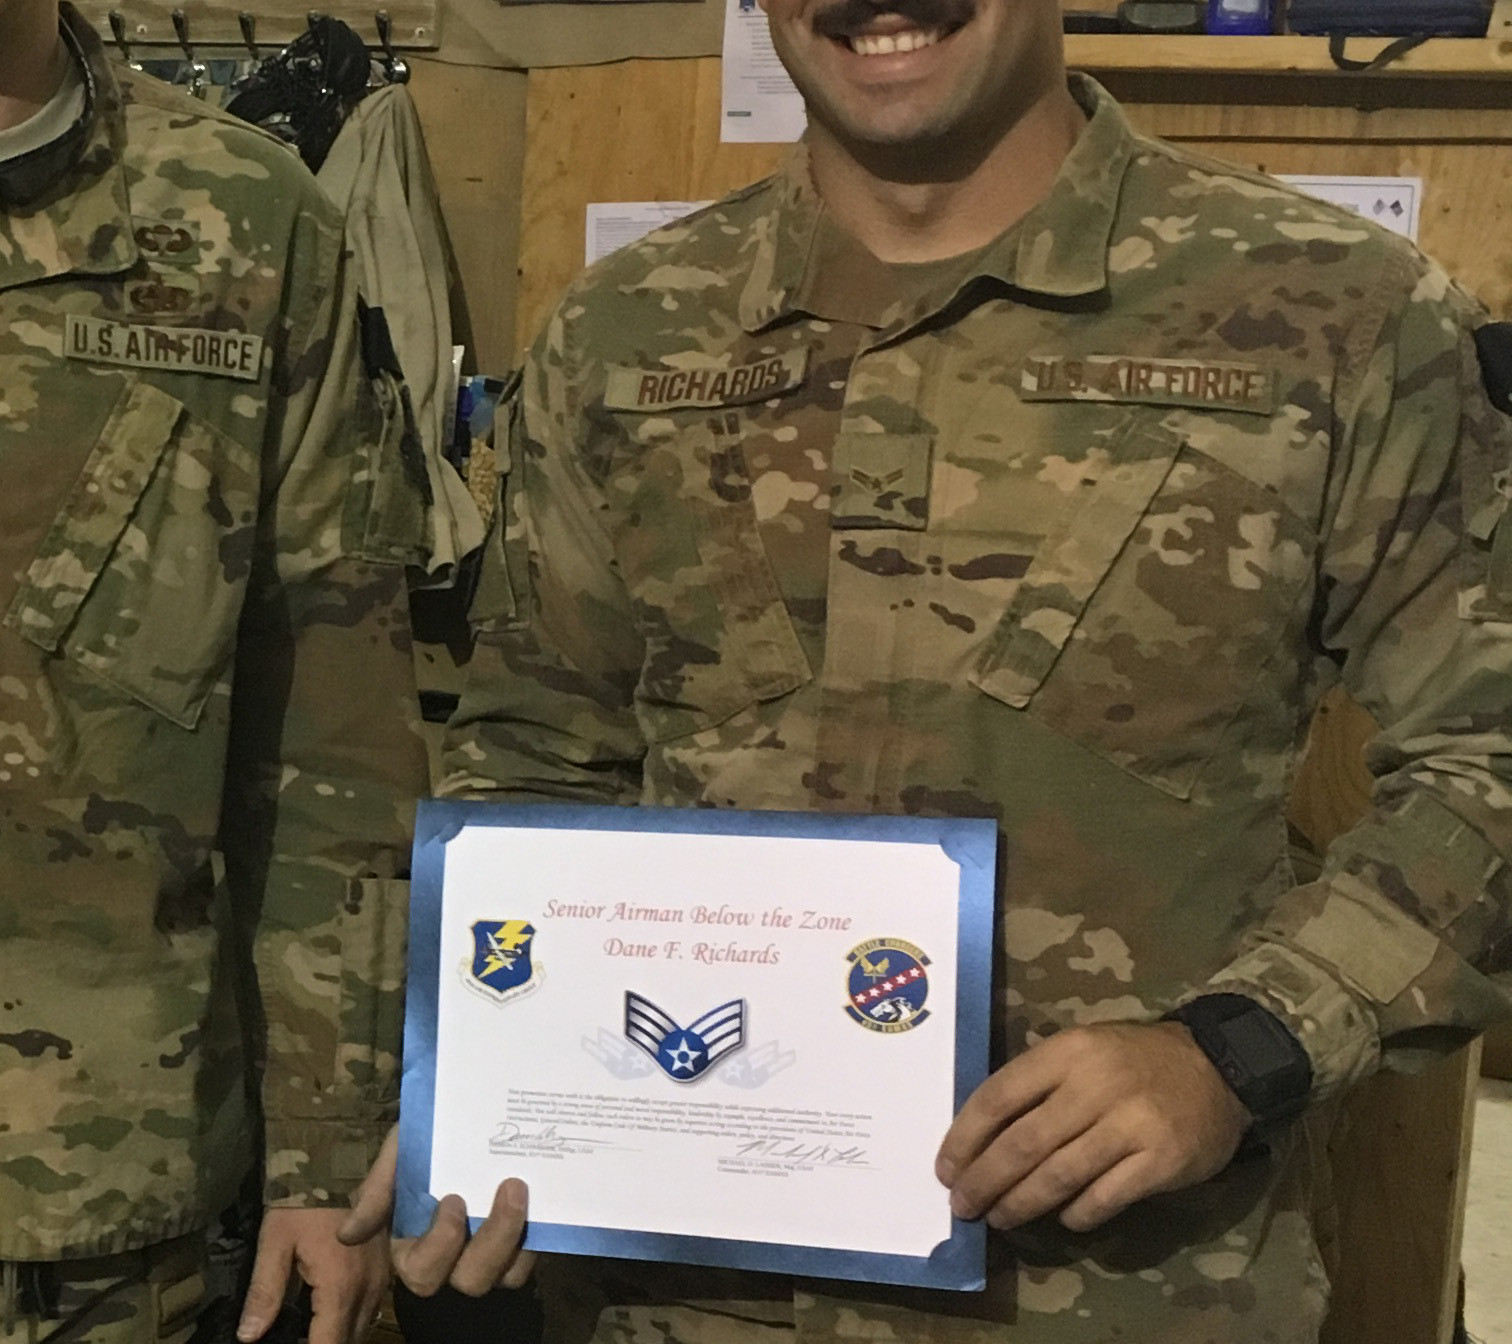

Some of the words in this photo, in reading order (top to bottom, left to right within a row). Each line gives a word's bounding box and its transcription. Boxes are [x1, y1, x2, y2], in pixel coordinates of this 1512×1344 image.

[73, 321, 121, 359] U.S.
[125, 326, 172, 363] AIR
[175, 333, 254, 373] FORCE
[636, 358, 785, 406] RICHARDS
[1101, 359, 1154, 397] AIR
[1165, 364, 1267, 402] FORCE
[542, 898, 606, 920] Senior
[606, 900, 684, 924] Airman
[690, 904, 755, 927] Below
[760, 906, 794, 929] the
[798, 910, 852, 932] Zone
[602, 937, 658, 959] Dane
[663, 940, 683, 960] F.
[690, 941, 780, 966] Richards
